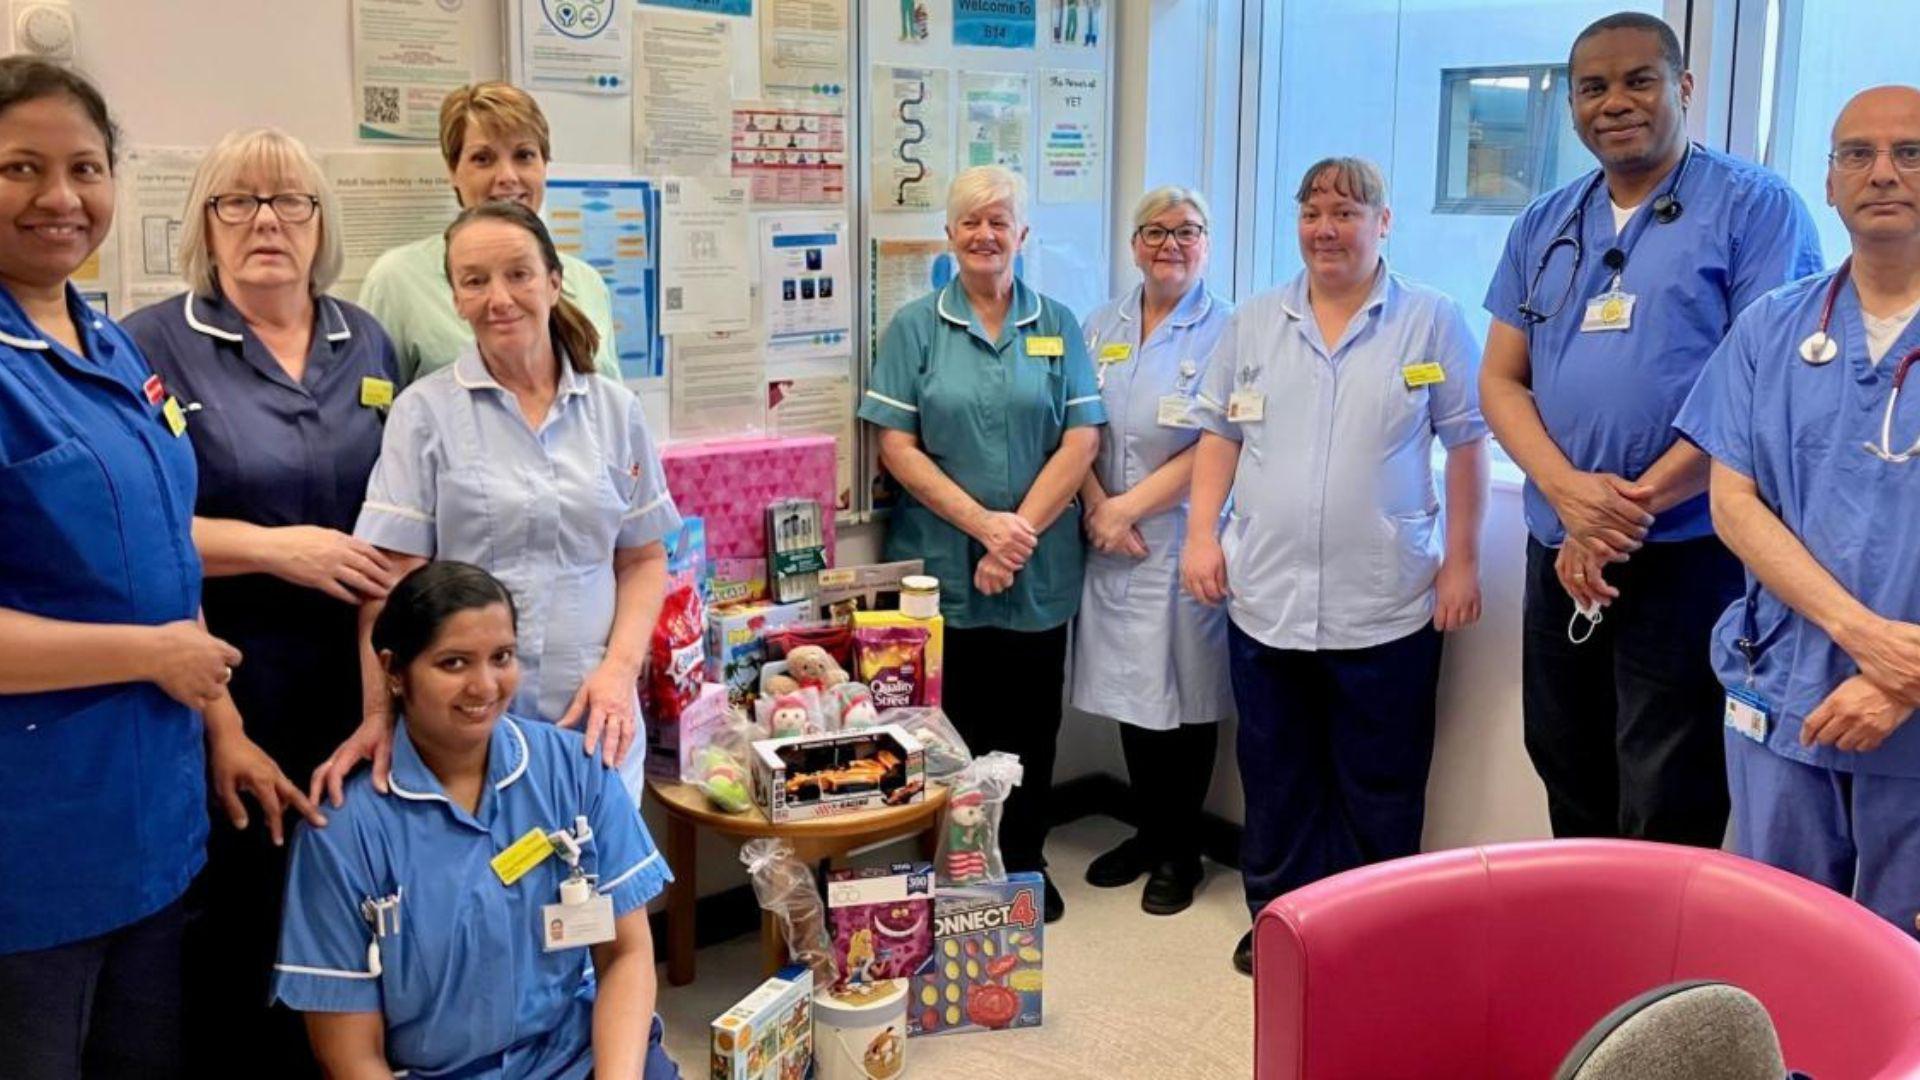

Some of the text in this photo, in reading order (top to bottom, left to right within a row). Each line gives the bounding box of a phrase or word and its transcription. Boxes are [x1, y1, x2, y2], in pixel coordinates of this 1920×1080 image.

[959, 0, 1031, 15] Welcome To
[1065, 96, 1082, 108] YET
[870, 680, 914, 694] Quality
[874, 693, 910, 706] Street
[908, 875, 928, 888] 300
[934, 889, 1037, 937] ONNECT 4
